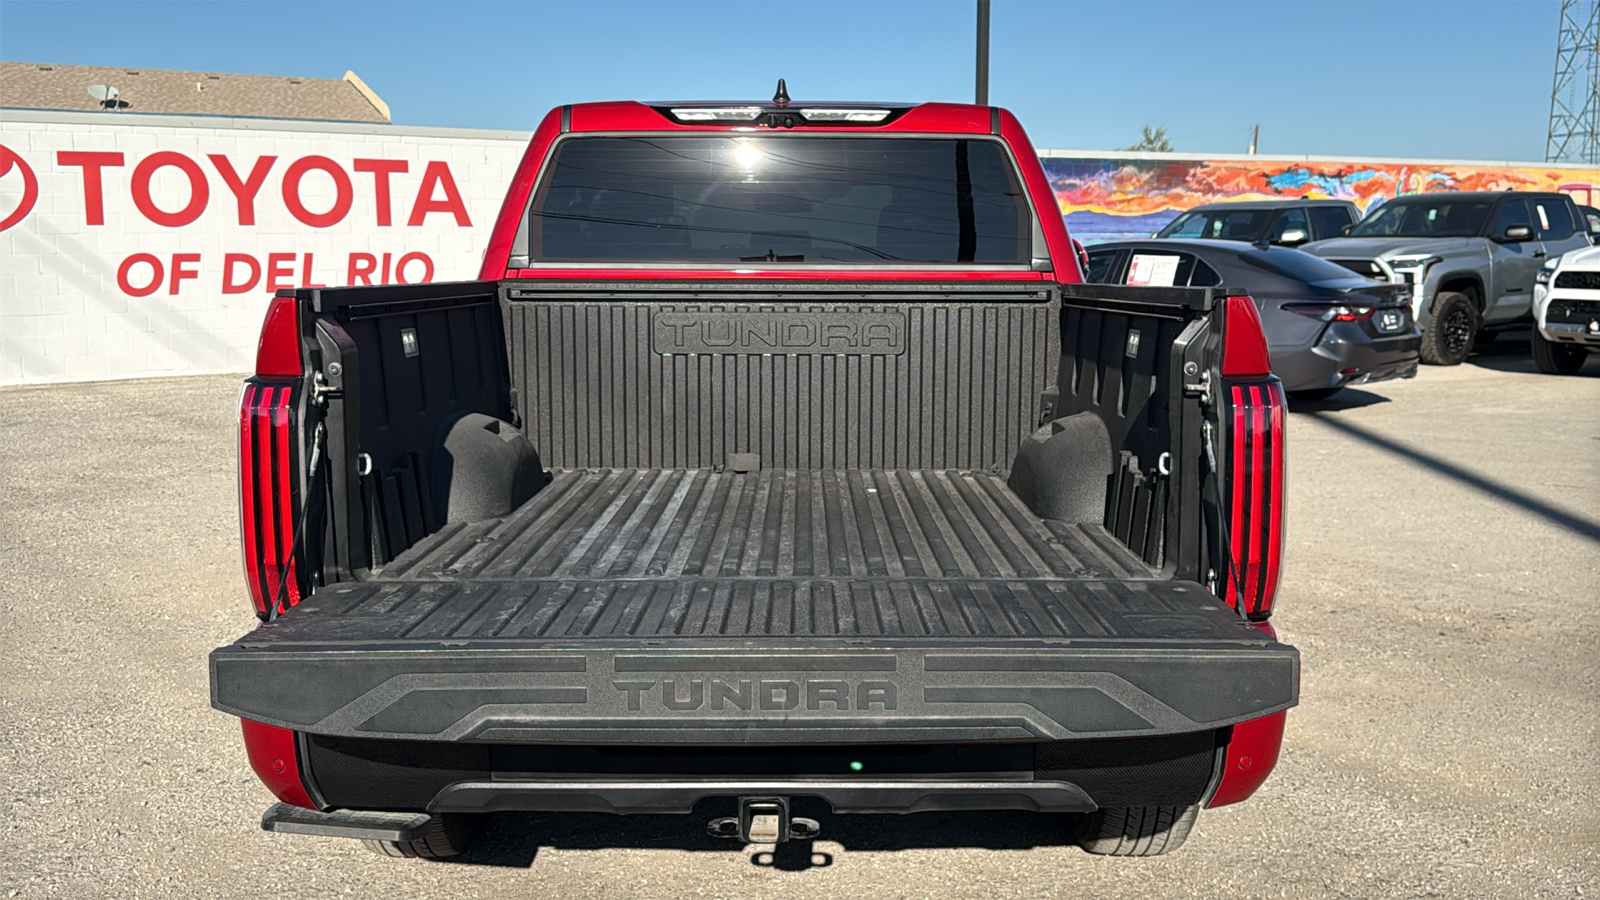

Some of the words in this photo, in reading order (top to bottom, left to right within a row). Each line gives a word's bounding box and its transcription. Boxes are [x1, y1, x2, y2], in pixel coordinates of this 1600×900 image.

[57, 151, 472, 227] TOYOTA
[117, 253, 200, 296] OF
[222, 253, 325, 293] DEL
[347, 252, 433, 286] RIO
[661, 320, 898, 347] TUNDRA
[612, 679, 898, 711] TUNDRA
